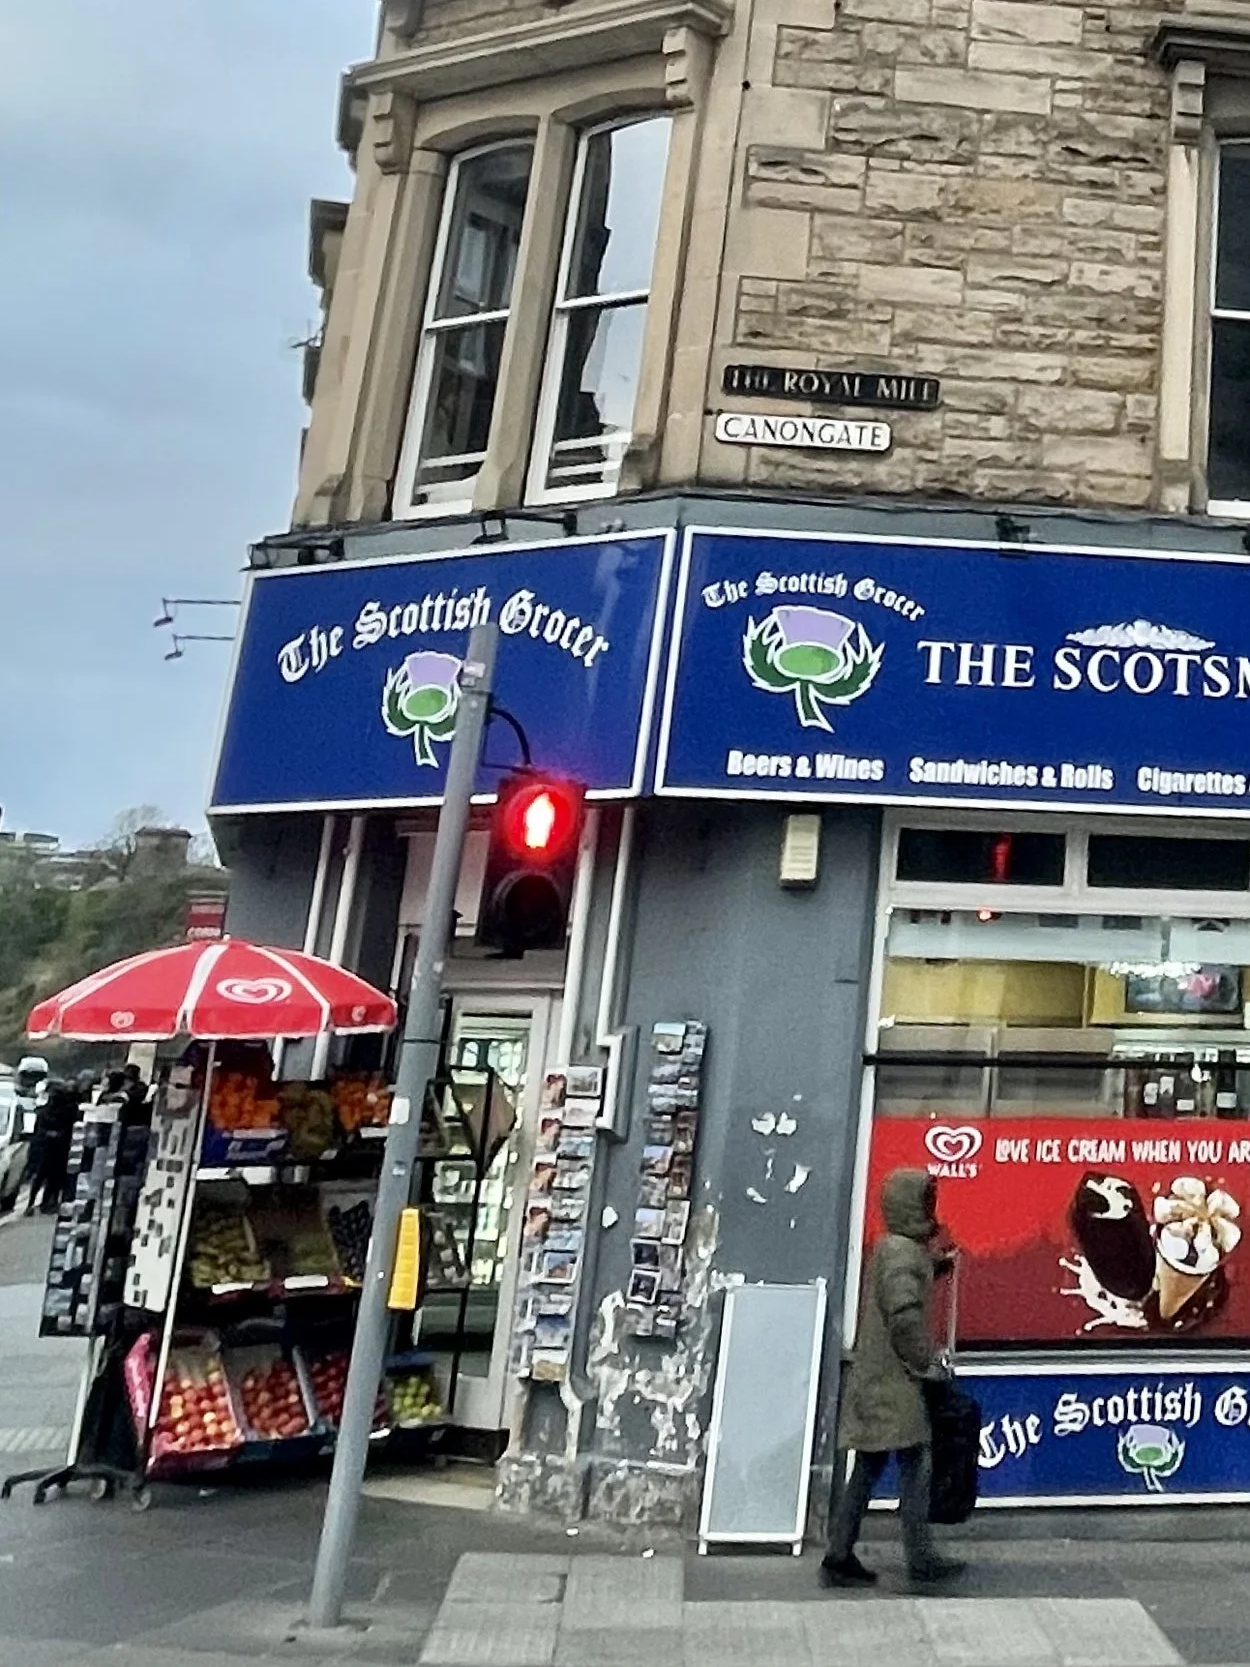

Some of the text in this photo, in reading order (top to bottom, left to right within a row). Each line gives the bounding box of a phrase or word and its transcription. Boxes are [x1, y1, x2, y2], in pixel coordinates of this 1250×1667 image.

[783, 370, 862, 398] ROYAL
[723, 417, 883, 447] CANONGATE
[701, 570, 926, 622] The Scottish Grocer
[278, 586, 609, 683] The Scottish Grocer
[916, 639, 1037, 688] THE
[726, 750, 885, 781] Beers & Wines
[909, 756, 1114, 791] Sandwiches & Rolls
[1137, 766, 1246, 796] Cigarettes
[994, 1137, 1030, 1164] LOVE
[1035, 1138, 1062, 1164] ICE
[1066, 1138, 1126, 1164] CREAM
[1131, 1139, 1181, 1163] WHEN
[1186, 1139, 1223, 1164] YOU
[927, 1162, 978, 1178] WALL'S
[977, 1412, 1042, 1469] The
[1053, 1381, 1202, 1437] Scottish
